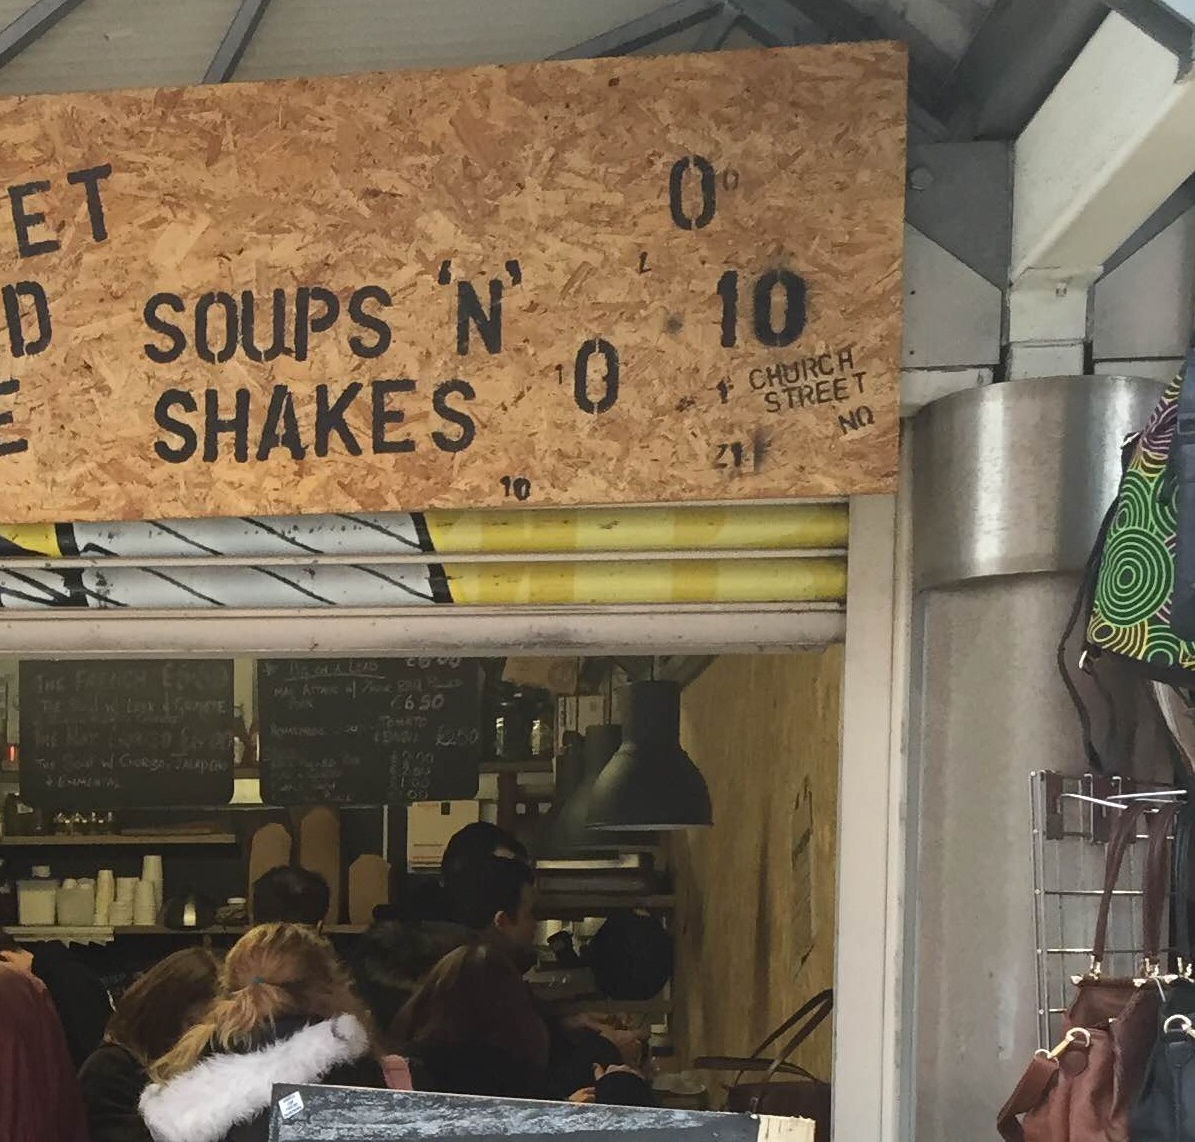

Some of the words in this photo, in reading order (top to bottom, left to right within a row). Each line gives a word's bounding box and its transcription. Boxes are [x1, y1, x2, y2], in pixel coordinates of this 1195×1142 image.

[143, 284, 392, 363] SOUPS
[717, 269, 808, 347] 10
[748, 346, 855, 391] CHURCH
[763, 371, 867, 413] STREET
[154, 379, 476, 463] SHAKES
[499, 475, 531, 500] 10
